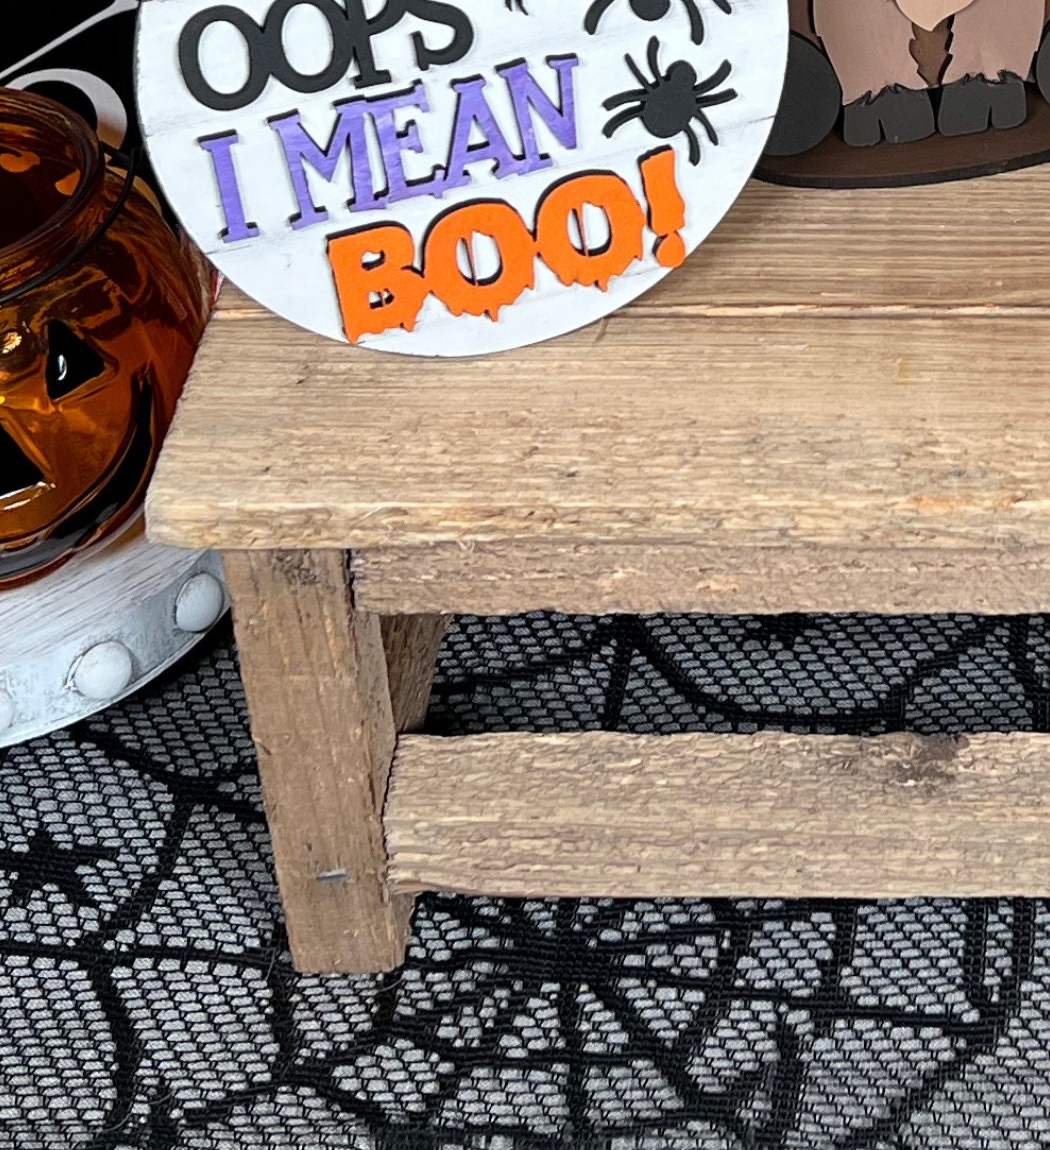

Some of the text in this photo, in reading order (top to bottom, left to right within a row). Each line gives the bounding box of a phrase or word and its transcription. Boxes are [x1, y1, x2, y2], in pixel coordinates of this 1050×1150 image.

[199, 129, 259, 243] I
[266, 53, 578, 232] MEAN
[327, 144, 686, 343] BOO!
